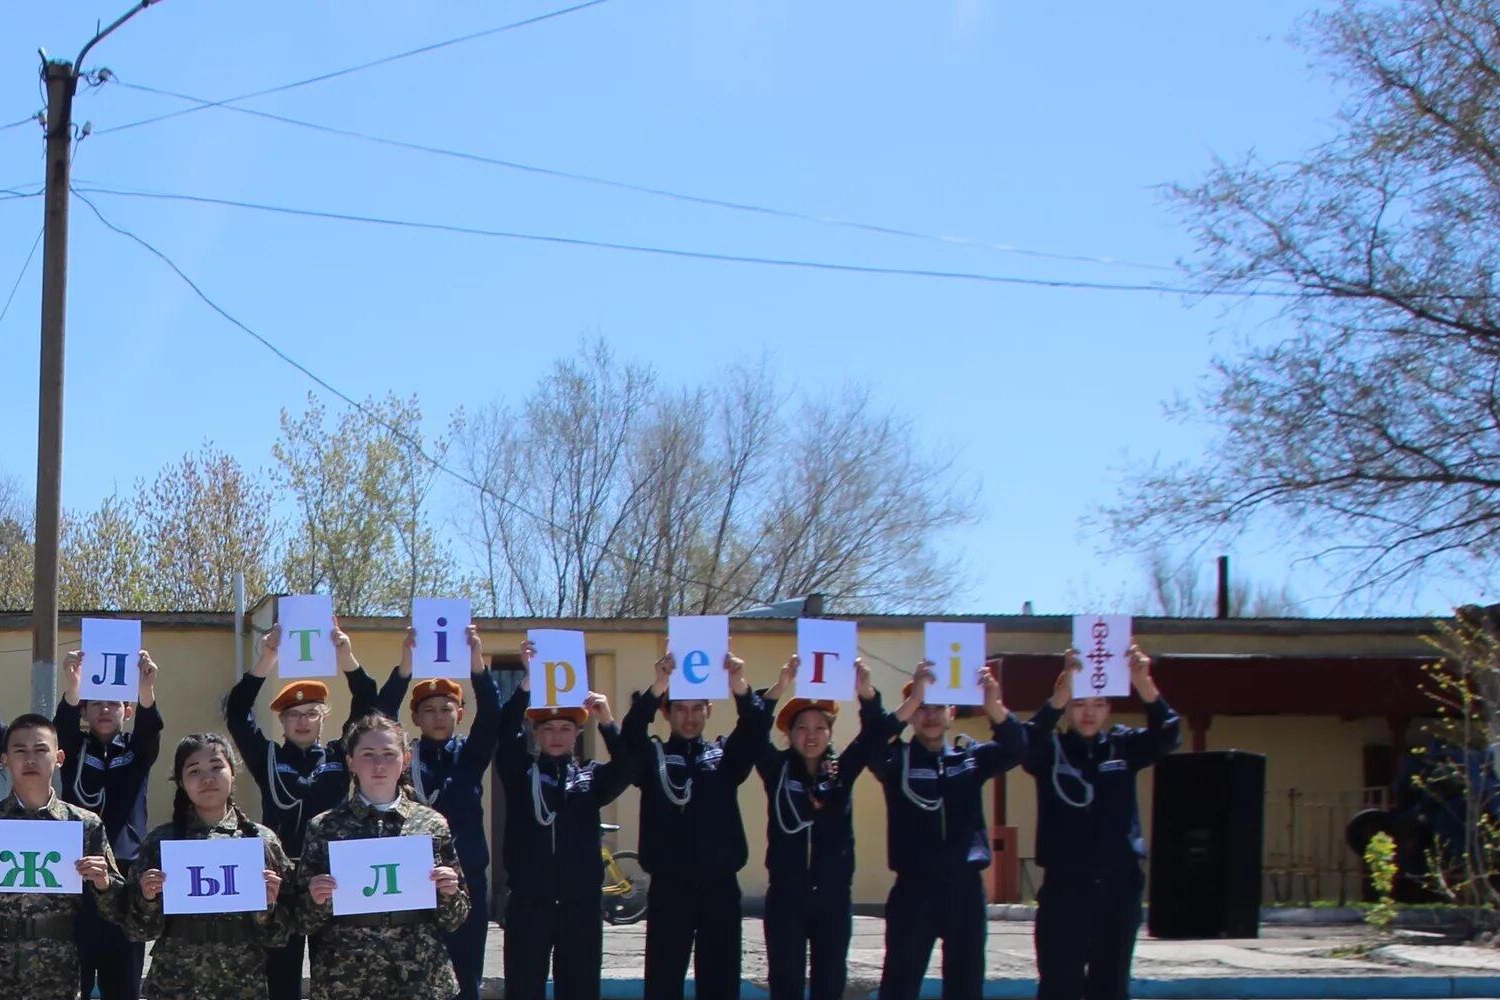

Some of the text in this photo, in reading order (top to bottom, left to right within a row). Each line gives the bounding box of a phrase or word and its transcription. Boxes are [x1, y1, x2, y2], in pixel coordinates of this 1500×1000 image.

[91, 652, 129, 686] л
[543, 661, 577, 707] р
[682, 650, 710, 684] е
[810, 651, 840, 684] г
